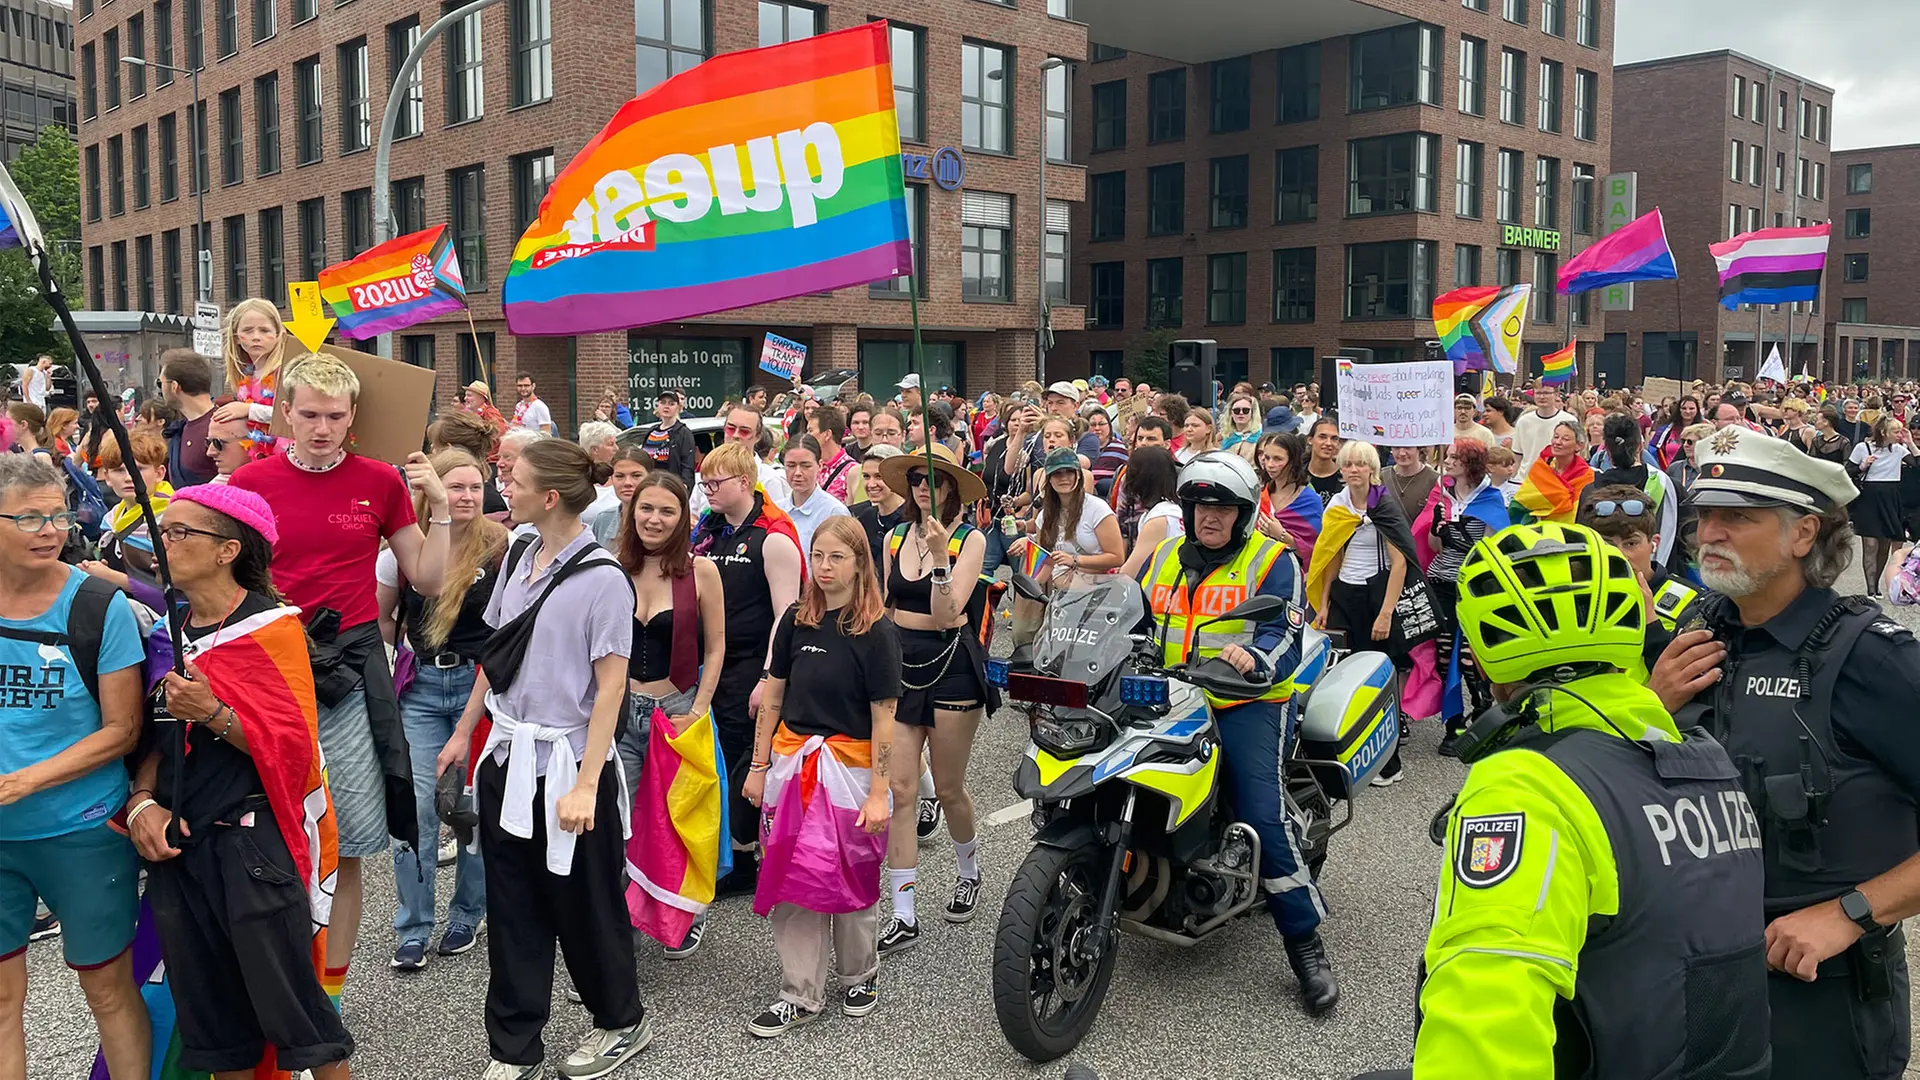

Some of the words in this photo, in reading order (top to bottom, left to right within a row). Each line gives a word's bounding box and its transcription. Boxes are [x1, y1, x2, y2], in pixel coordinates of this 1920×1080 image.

[1504, 225, 1560, 250] BARMER
[627, 349, 667, 364] ächen
[671, 350, 688, 364] ab
[692, 351, 708, 363] 10
[711, 353, 733, 367] qm
[771, 346, 798, 365] TRANS
[767, 356, 794, 377] YOUTH
[1368, 372, 1390, 381] never
[1392, 367, 1412, 381] about
[1415, 366, 1444, 383] making
[628, 373, 655, 388] nfos
[659, 375, 701, 388] unter:
[1396, 389, 1421, 402] queer
[1384, 405, 1414, 423] making
[1418, 408, 1438, 421] your
[1389, 423, 1419, 439] DEAD
[328, 514, 350, 524] CSD
[353, 514, 372, 523] KIEL
[1352, 711, 1395, 778] POLIZEI
[1467, 821, 1517, 834] POLIZEI
